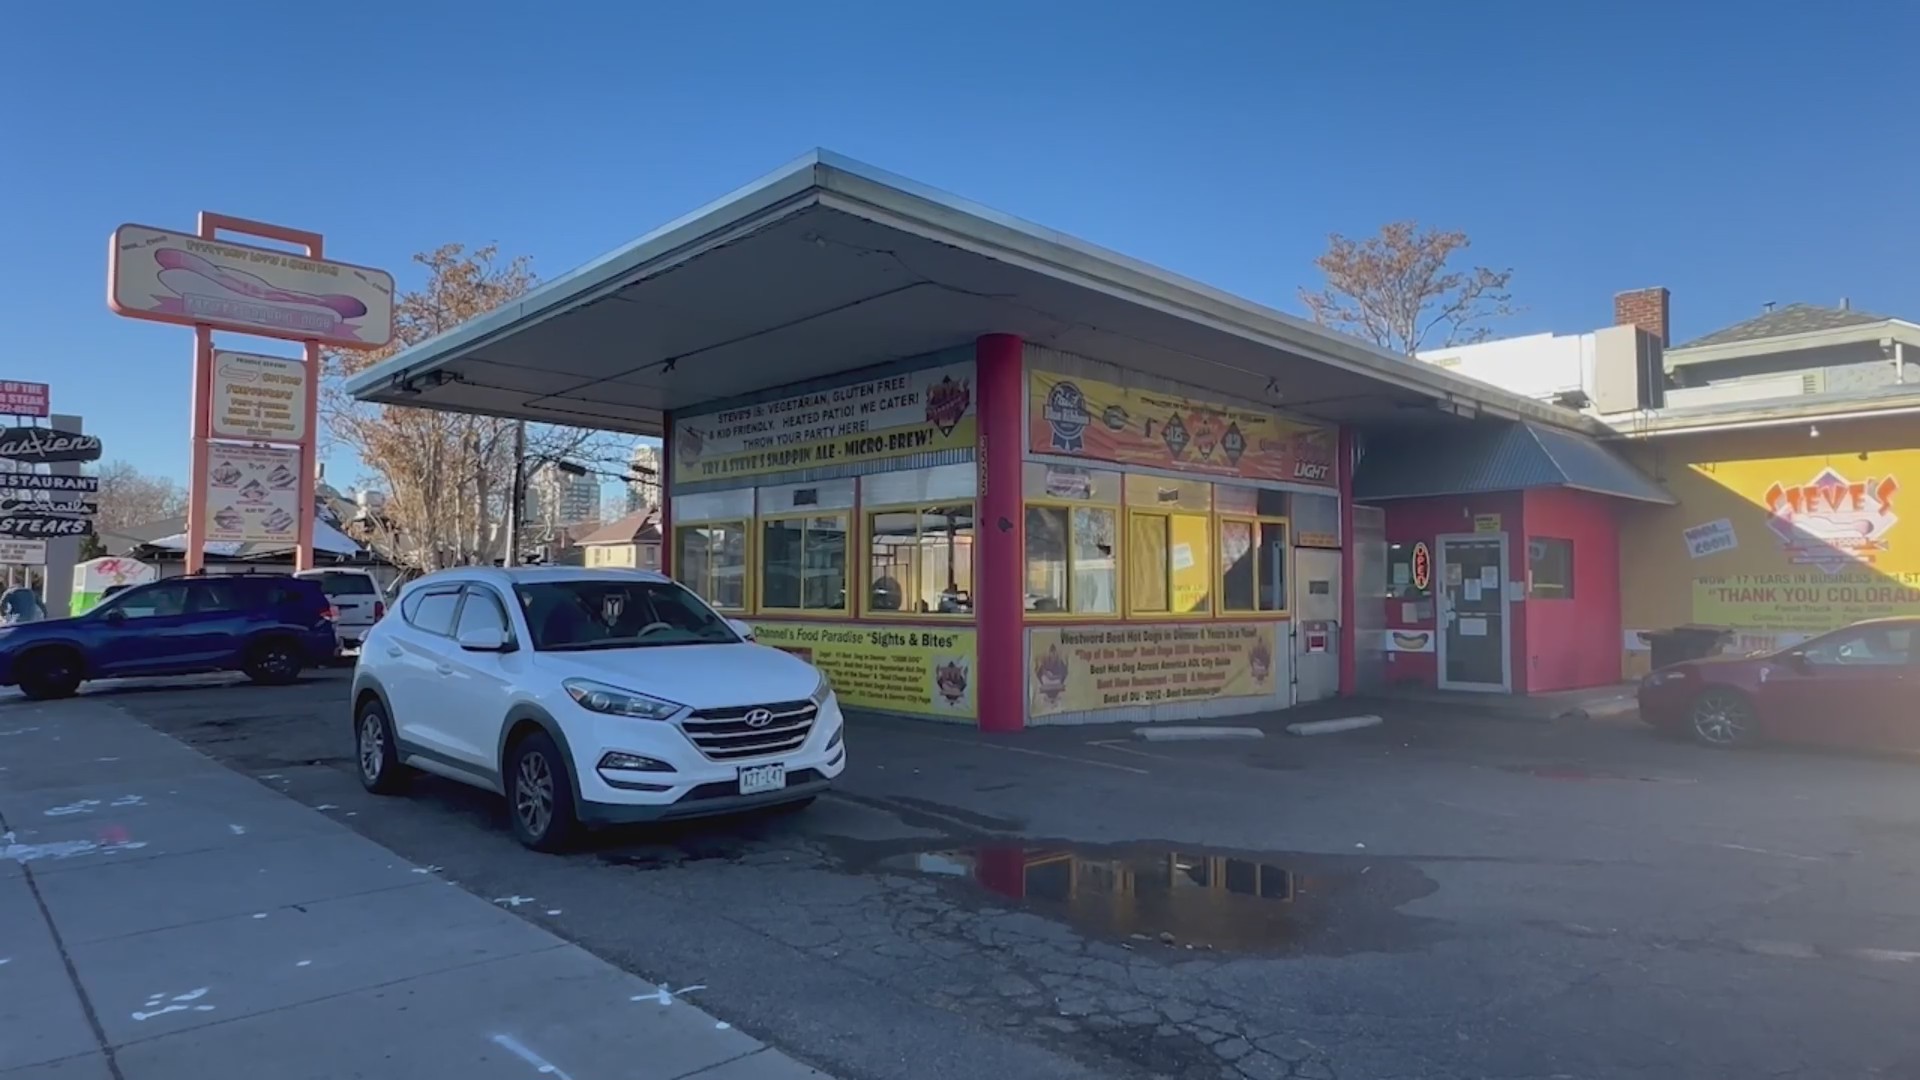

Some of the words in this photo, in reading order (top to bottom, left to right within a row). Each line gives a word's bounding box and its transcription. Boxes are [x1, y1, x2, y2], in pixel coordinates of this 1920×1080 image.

[4, 383, 19, 392] OF
[22, 384, 42, 394] THE
[833, 384, 874, 401] GLUTEN
[877, 377, 905, 392] FREE
[8, 394, 45, 405] STEAK
[717, 428, 731, 439] KID
[783, 412, 820, 428] HEATED
[860, 401, 876, 414] WE
[880, 393, 919, 411] CATER!
[743, 437, 774, 450] THROW
[777, 432, 802, 444] YOUR
[805, 427, 834, 440] PARTY
[702, 459, 720, 475] TRY
[816, 443, 835, 460] ALE
[1294, 462, 1328, 479] LIGHT
[0, 474, 96, 490] ESTAURANT
[1765, 475, 1899, 517] STEVE'S
[0, 518, 86, 533] STEAKS
[1416, 547, 1425, 585] OPEN
[1736, 575, 1748, 584] 17
[1752, 575, 1790, 584] YEARS
[1794, 575, 1806, 584] IN
[1810, 574, 1871, 584] BUSINESS
[1905, 573, 1920, 583] ST
[1782, 587, 1819, 602] YOU
[1827, 587, 1920, 603] COLORAD
[754, 625, 794, 641] Channel's
[796, 628, 819, 642] Food
[821, 629, 863, 644] Paradise
[908, 634, 918, 646] &
[1060, 630, 1104, 645] Westword
[1127, 631, 1141, 642] Hot
[1090, 664, 1106, 674] Best
[1108, 663, 1120, 673] Hot
[1122, 662, 1135, 674] Dog
[1137, 661, 1159, 671] Across
[1161, 660, 1186, 669] America
[1201, 658, 1213, 669] City
[1104, 693, 1119, 703] Best
[1121, 693, 1128, 702] of
